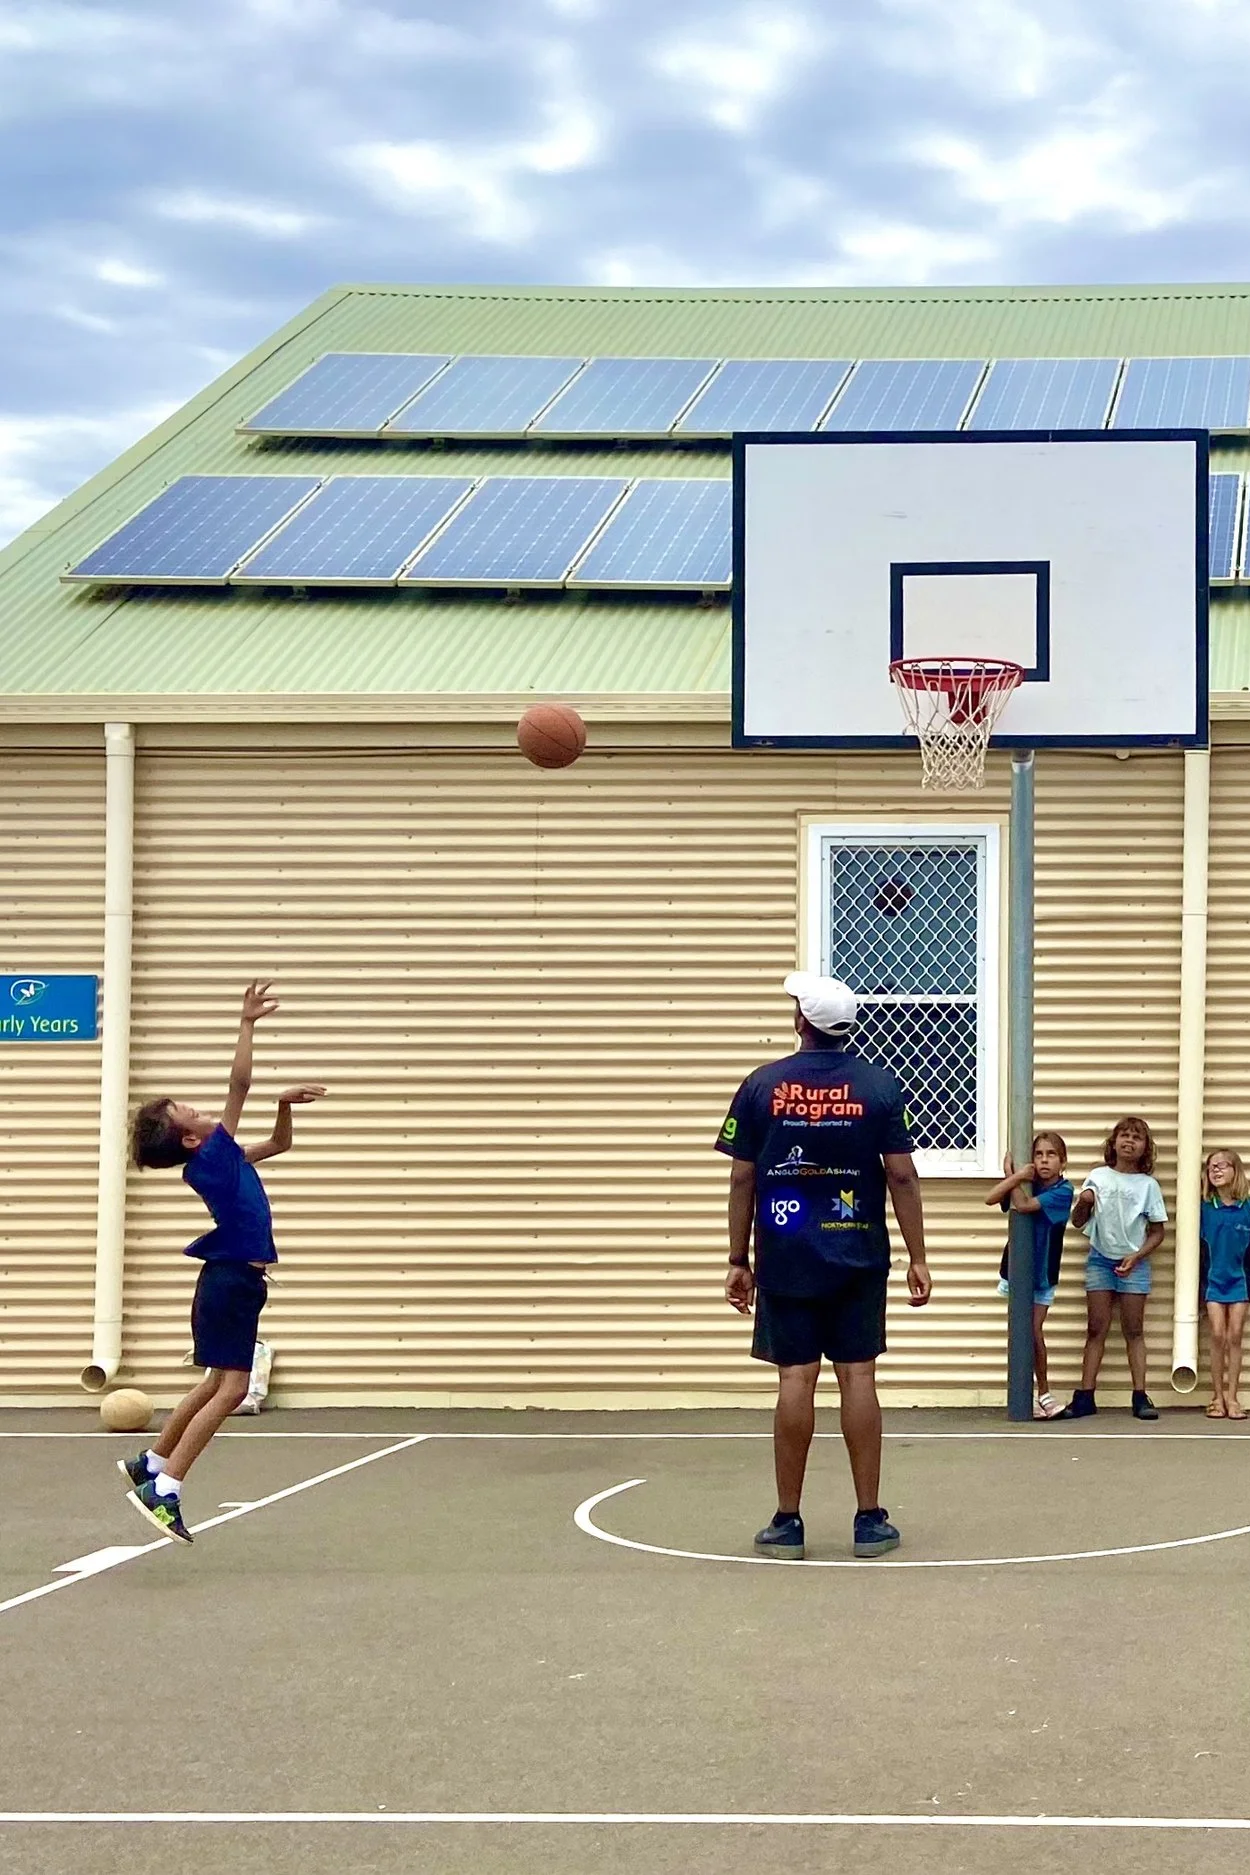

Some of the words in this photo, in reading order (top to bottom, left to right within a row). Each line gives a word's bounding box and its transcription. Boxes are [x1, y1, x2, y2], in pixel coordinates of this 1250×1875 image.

[0, 1014, 25, 1036] rly
[30, 1015, 79, 1033] Years
[789, 1083, 849, 1100] Rural
[772, 1099, 863, 1119] Program
[771, 1198, 800, 1226] igo
